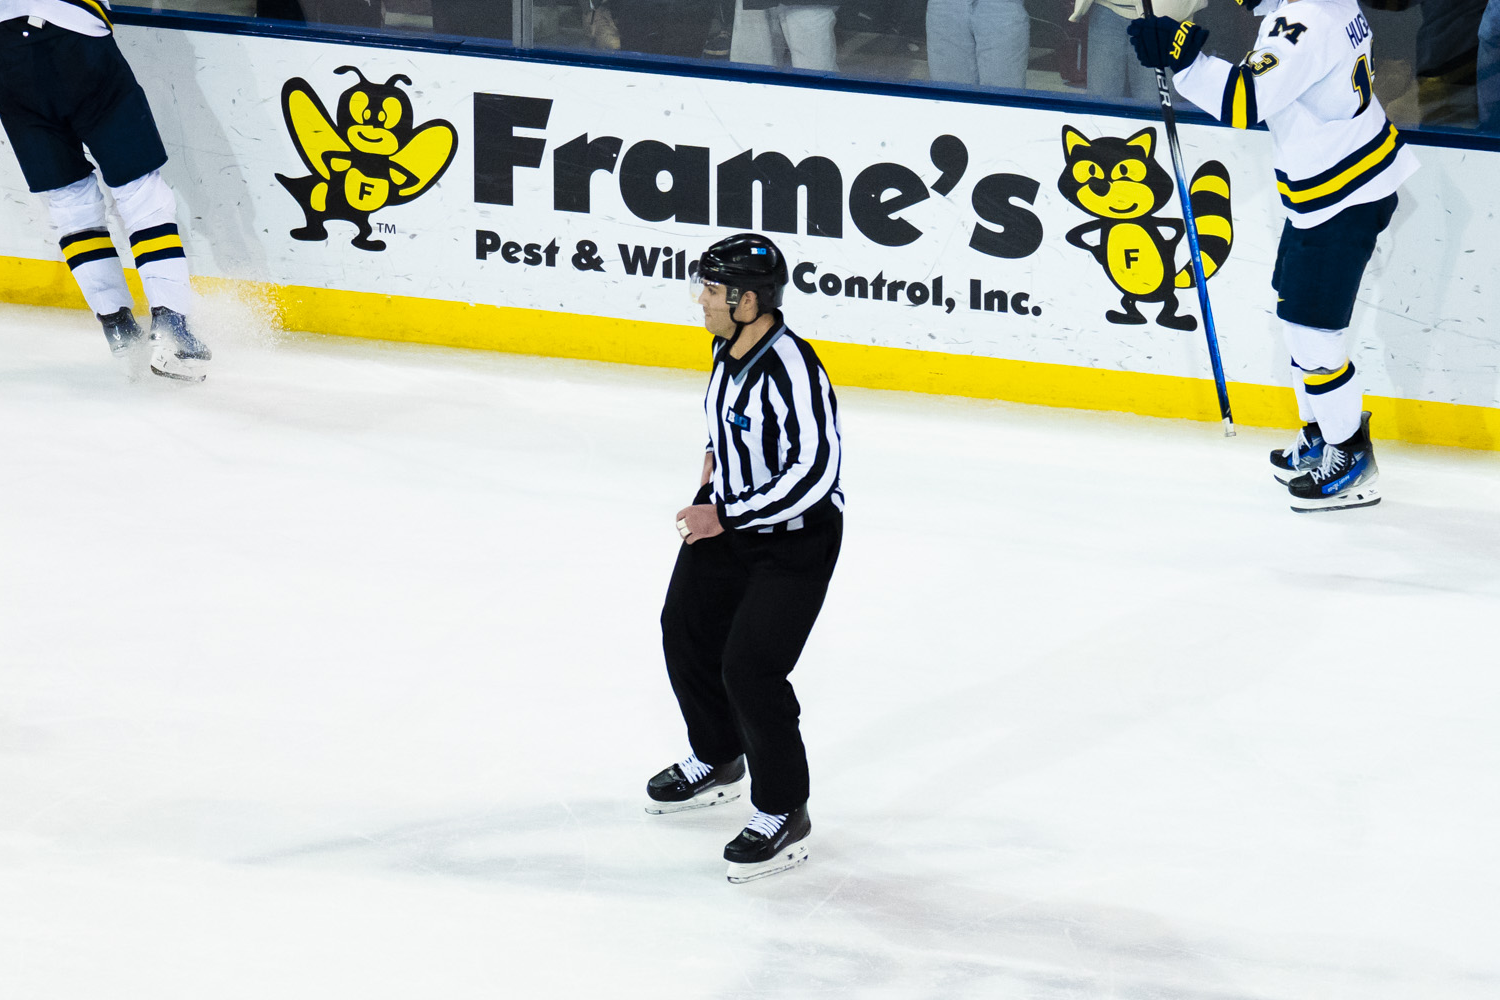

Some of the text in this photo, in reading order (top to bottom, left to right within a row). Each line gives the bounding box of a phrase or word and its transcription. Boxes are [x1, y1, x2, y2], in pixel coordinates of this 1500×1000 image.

[1268, 16, 1308, 46] M
[473, 92, 1044, 259] Frame's
[358, 182, 375, 201] F
[376, 223, 397, 235] TM
[1124, 248, 1140, 270] F
[475, 229, 561, 268] Pest
[571, 239, 607, 273] &
[792, 261, 956, 314] Control,
[969, 278, 1043, 317] Inc.
